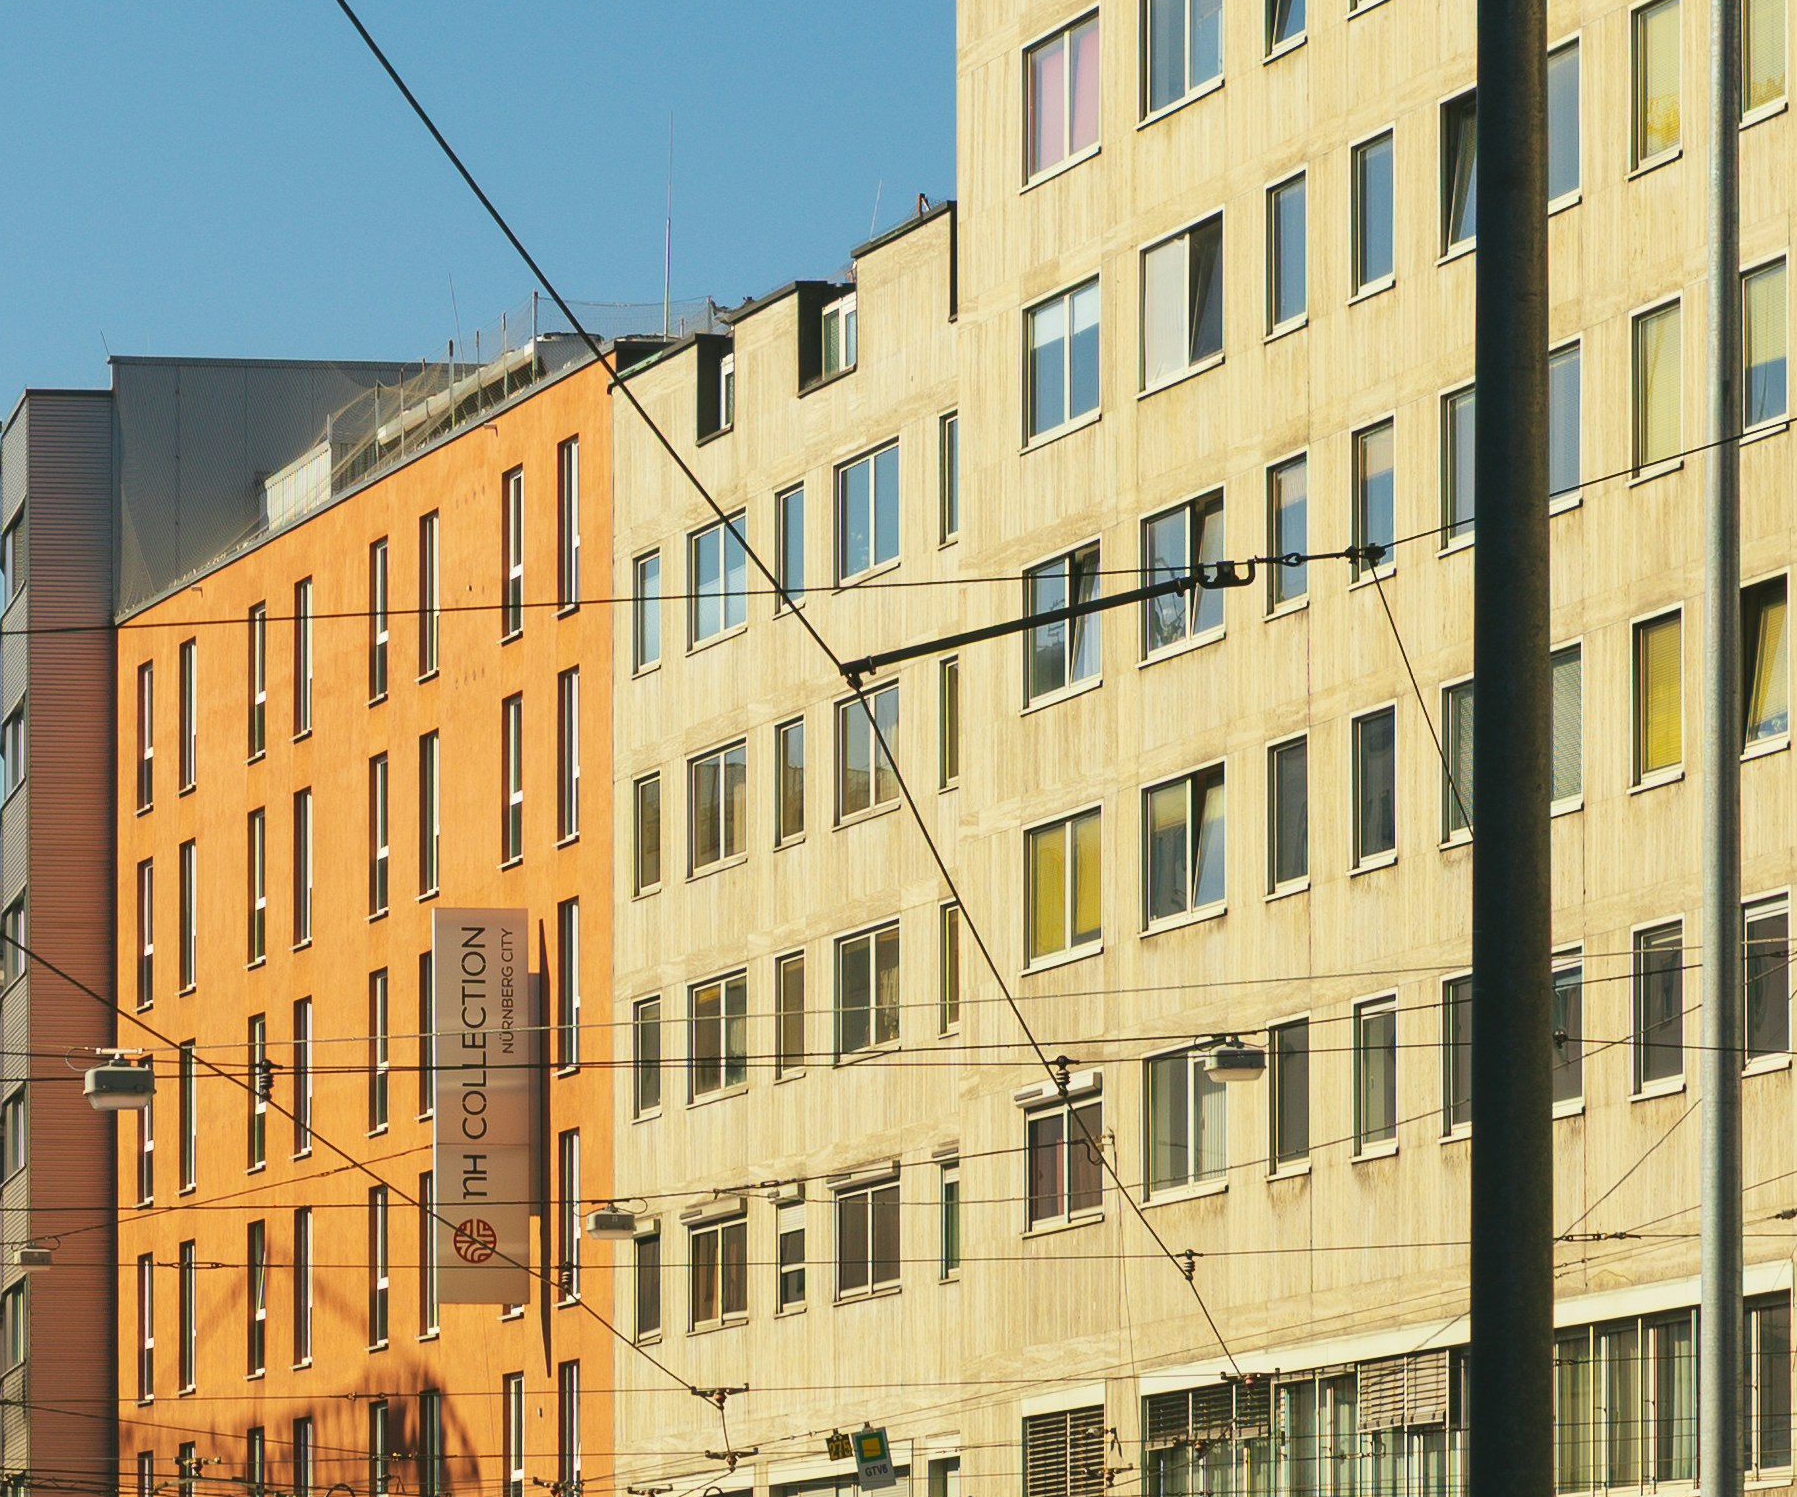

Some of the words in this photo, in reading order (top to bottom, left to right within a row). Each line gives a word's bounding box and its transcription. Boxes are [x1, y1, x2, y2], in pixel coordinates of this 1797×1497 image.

[501, 928, 513, 962] CITY
[461, 926, 488, 1140] COLLECTION
[499, 966, 514, 1053] NÜRNBERG
[829, 1439, 852, 1460] 275
